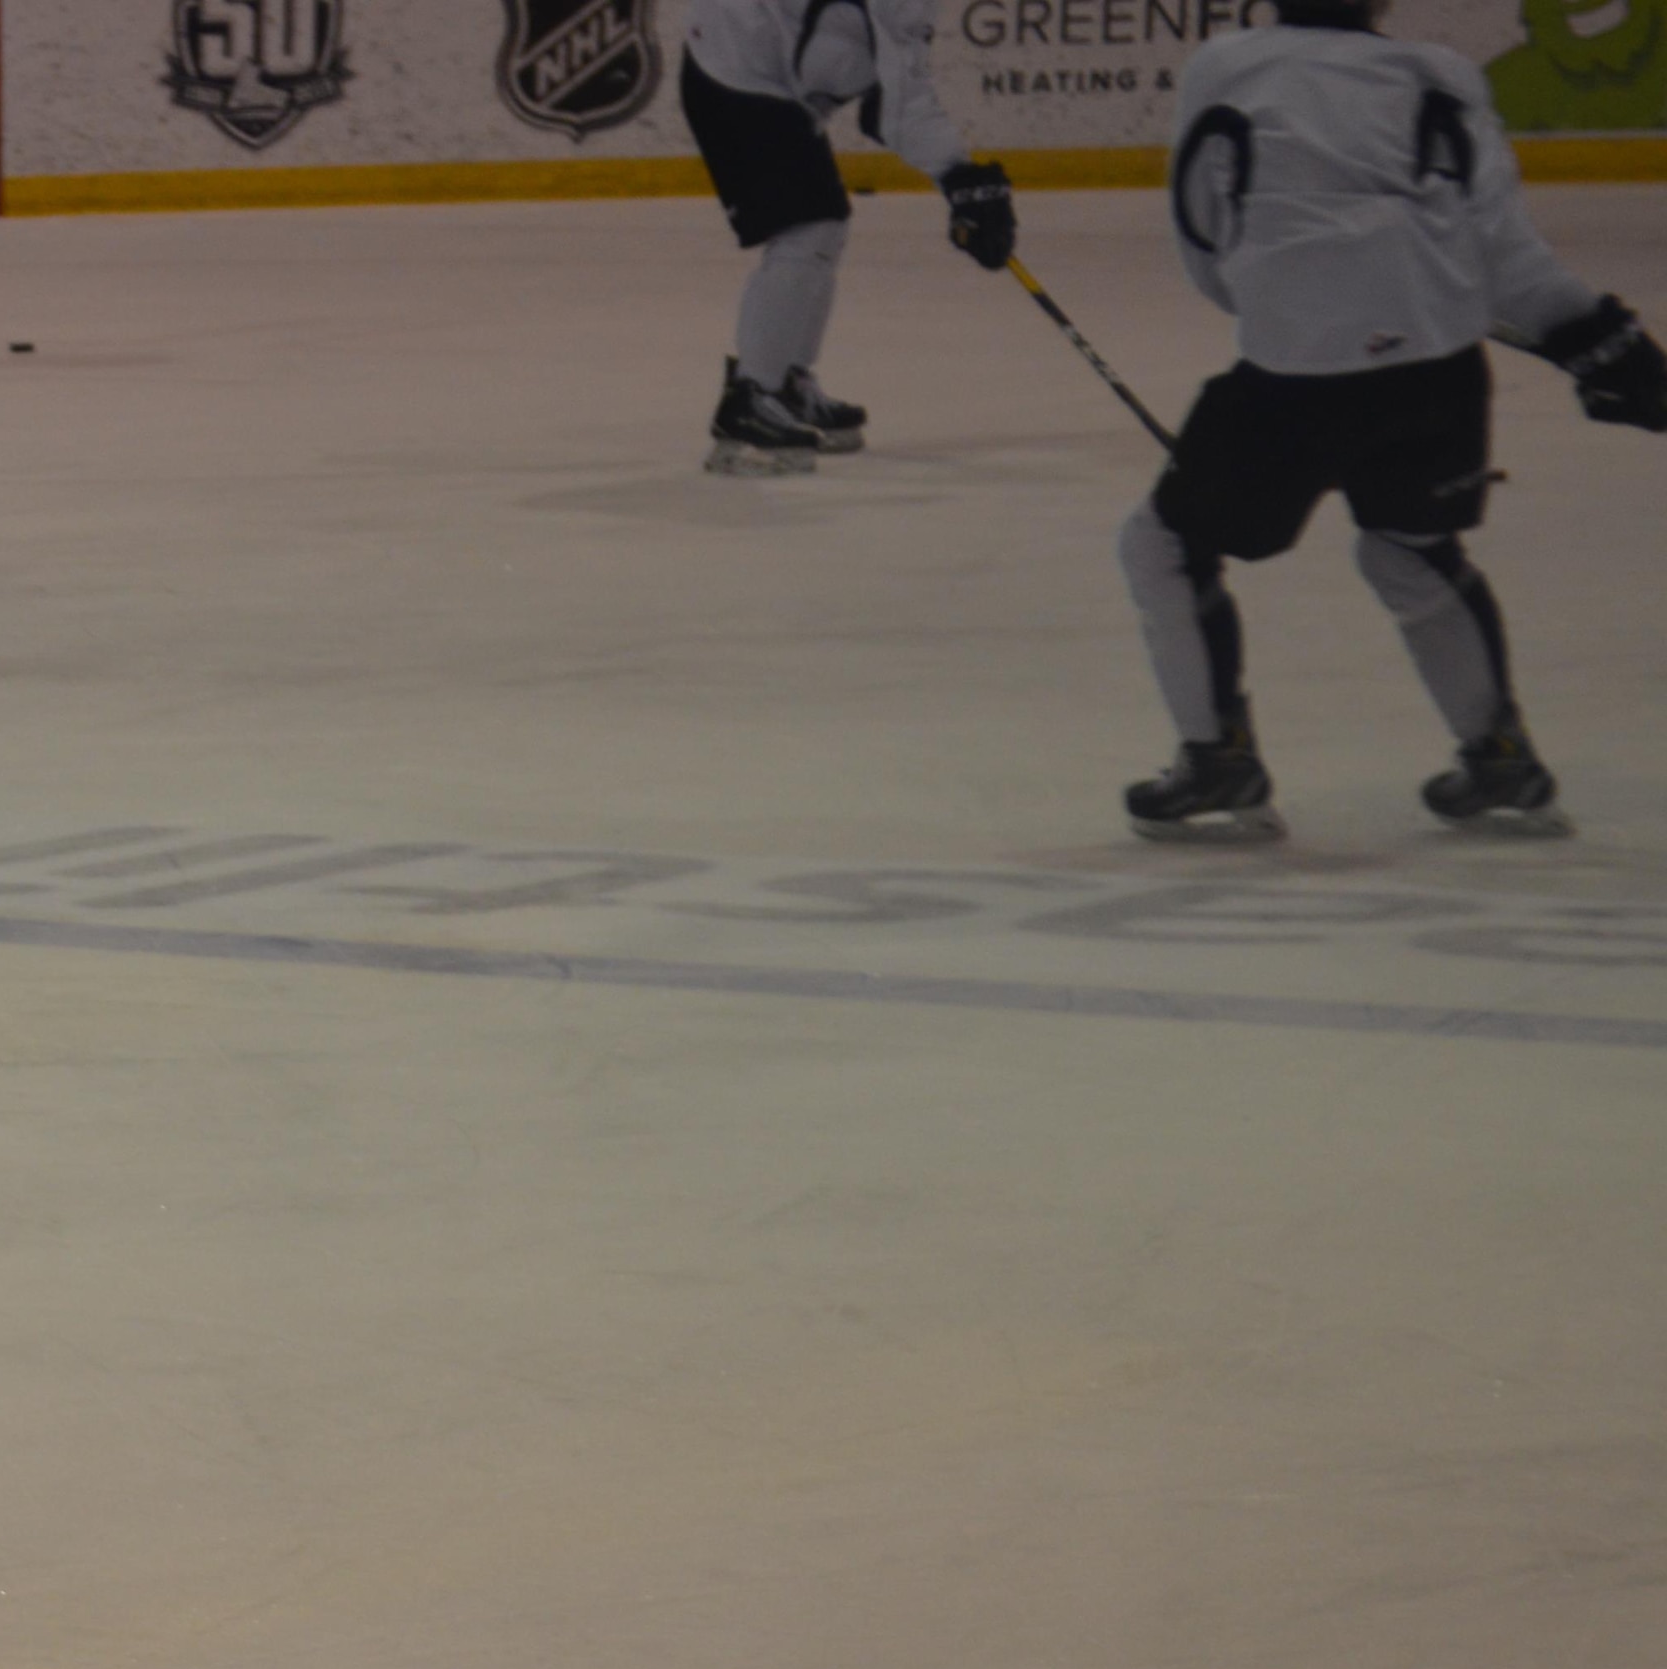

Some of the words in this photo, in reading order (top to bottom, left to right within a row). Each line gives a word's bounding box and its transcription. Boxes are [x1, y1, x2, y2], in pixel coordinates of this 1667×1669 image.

[534, 7, 631, 102] NHL
[983, 69, 1139, 94] HEATING
[1155, 68, 1174, 91] &
